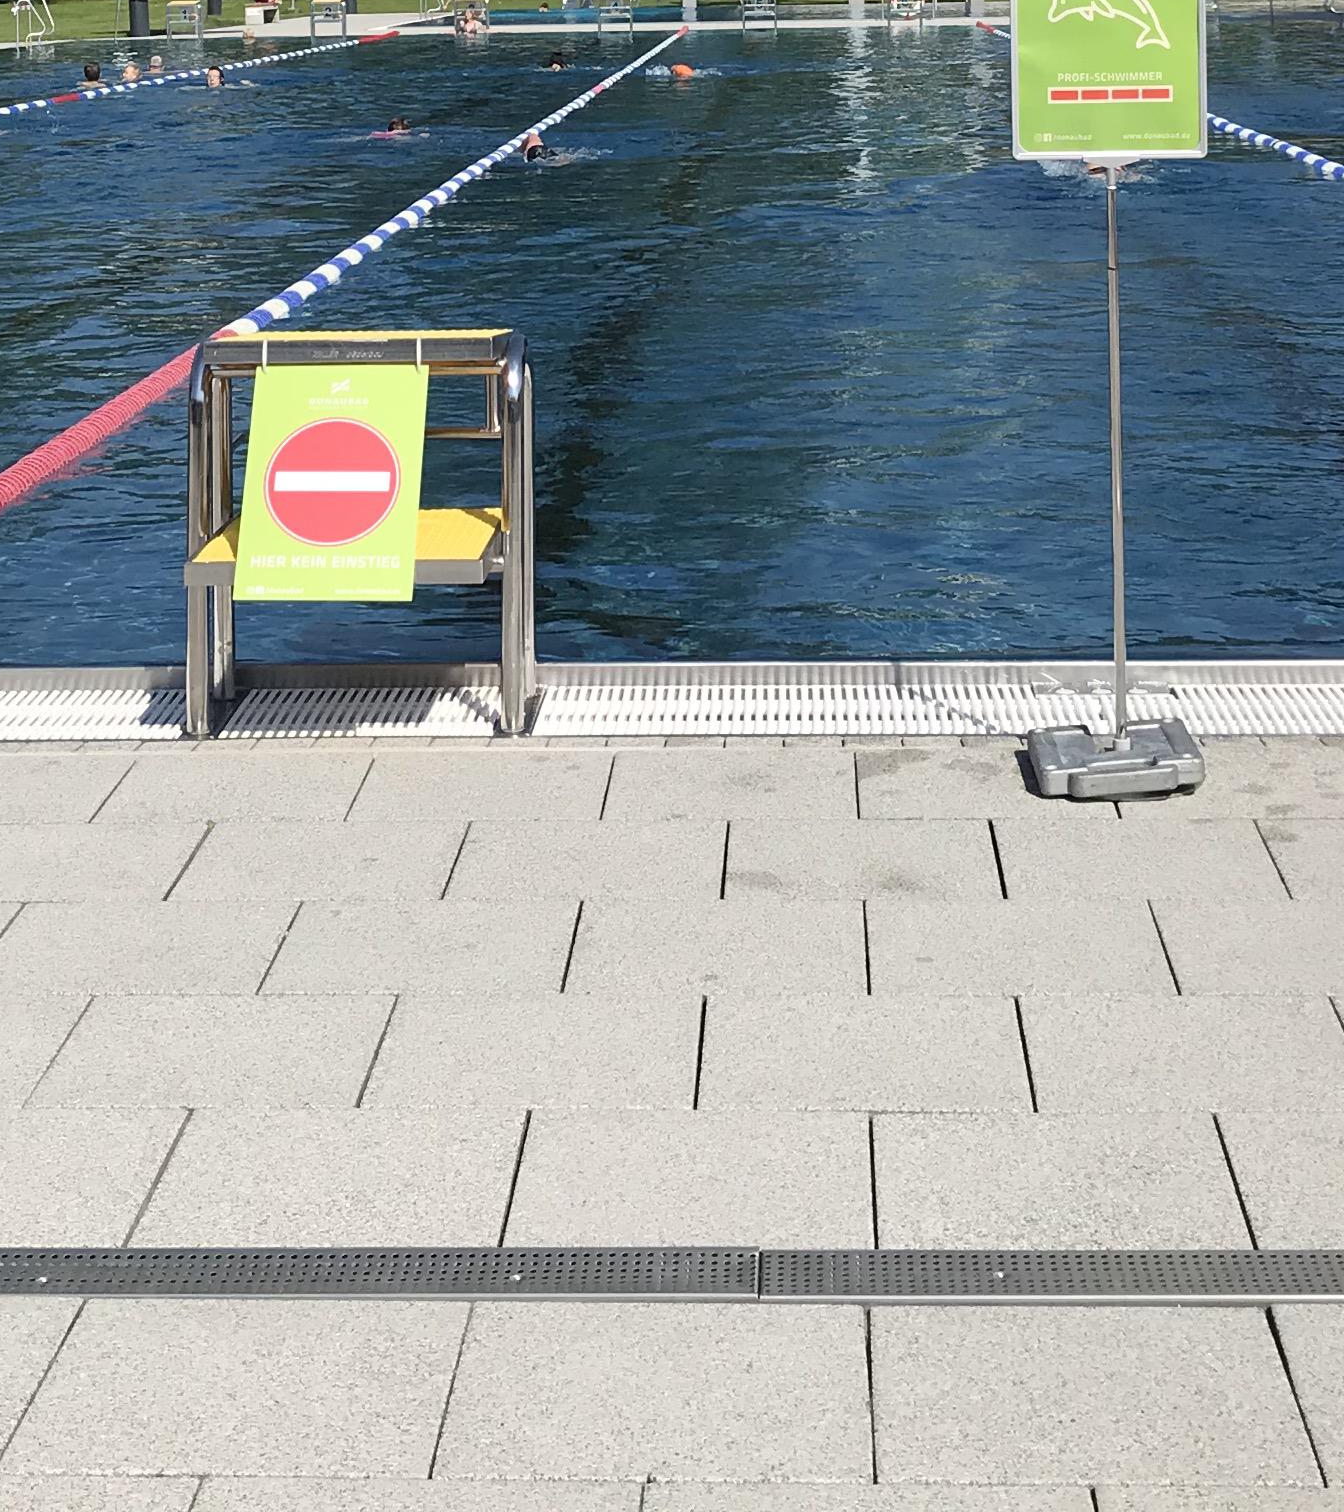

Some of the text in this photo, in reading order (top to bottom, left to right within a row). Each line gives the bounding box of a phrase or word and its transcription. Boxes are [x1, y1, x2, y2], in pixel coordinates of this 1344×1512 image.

[1057, 71, 1163, 82] PROFI-SCHWIMMER
[250, 554, 401, 569] HIER KEIN EINSTIEG
